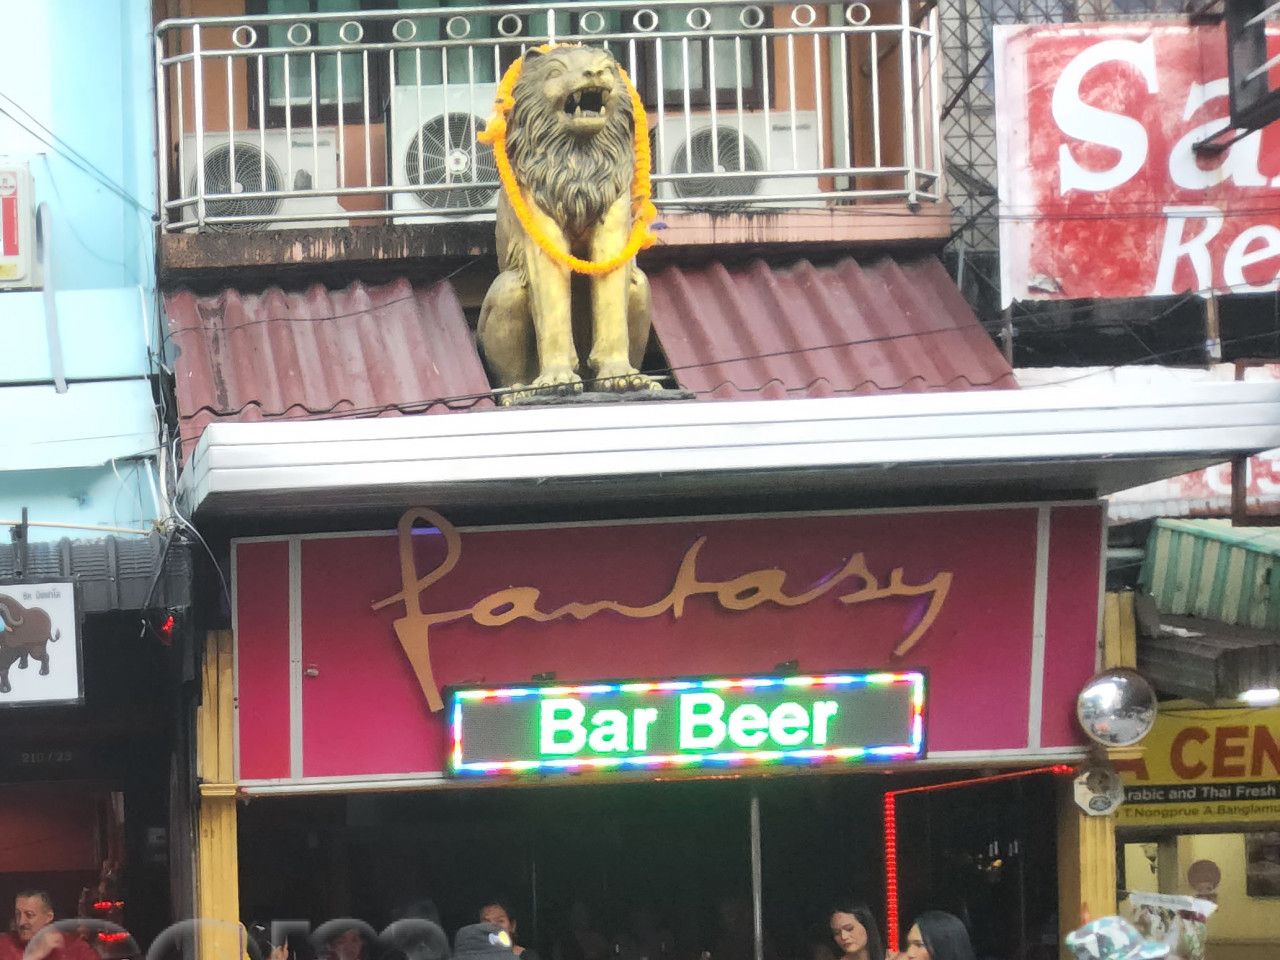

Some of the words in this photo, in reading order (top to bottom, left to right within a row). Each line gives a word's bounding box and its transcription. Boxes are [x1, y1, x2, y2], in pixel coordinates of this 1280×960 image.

[538, 697, 659, 755] Bar
[677, 690, 840, 749] Beer
[1126, 787, 1165, 801] rabic
[1168, 786, 1197, 800] and
[1201, 786, 1232, 799] Thai
[1236, 784, 1276, 798] Fresh
